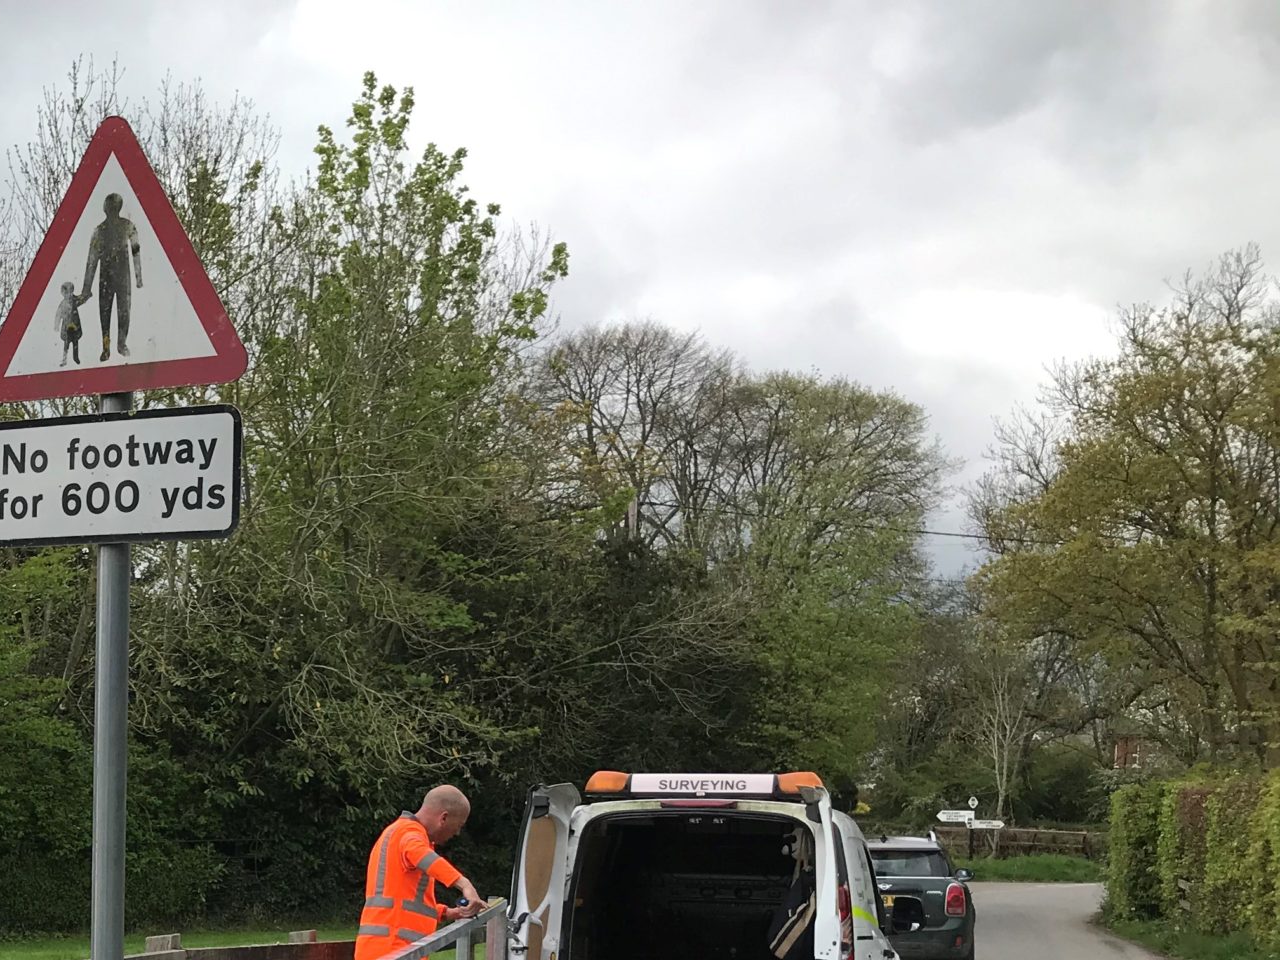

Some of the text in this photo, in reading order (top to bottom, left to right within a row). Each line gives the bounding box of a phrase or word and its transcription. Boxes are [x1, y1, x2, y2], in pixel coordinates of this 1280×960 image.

[3, 435, 217, 474] No footway
[62, 480, 139, 516] 600
[161, 477, 225, 518] yds
[659, 780, 746, 790] SURVEYING
